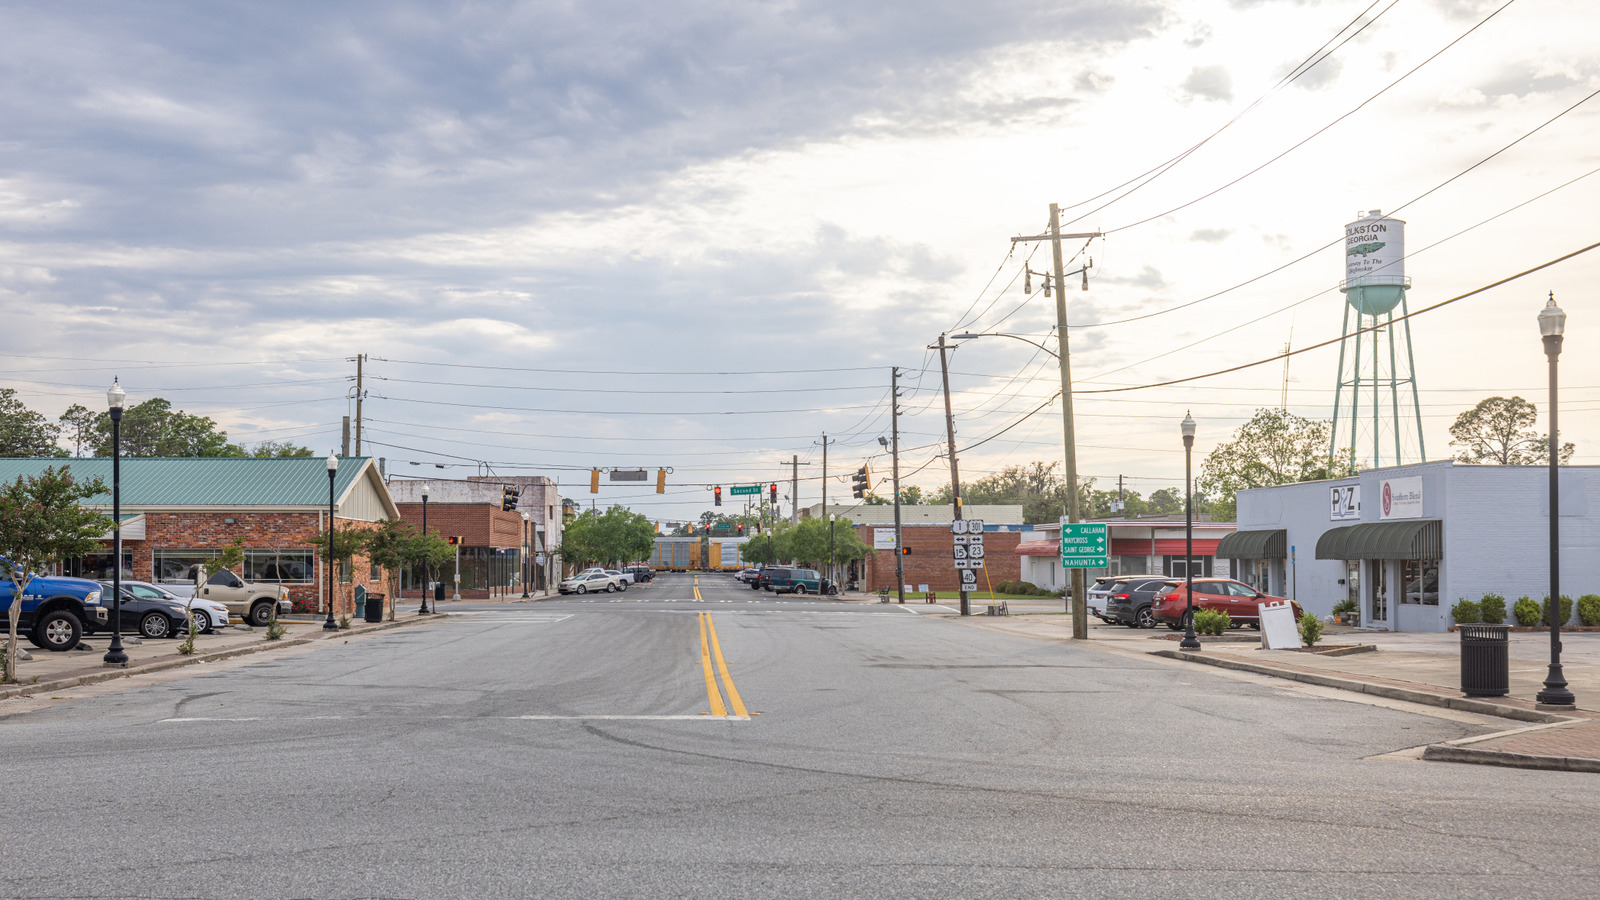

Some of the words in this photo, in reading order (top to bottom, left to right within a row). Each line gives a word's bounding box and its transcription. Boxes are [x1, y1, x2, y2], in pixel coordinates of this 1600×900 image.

[1346, 224, 1387, 236] OLKSTON
[1347, 234, 1378, 245] GEORGIA
[1409, 490, 1421, 500] Blend
[971, 522, 981, 531] 301
[955, 548, 964, 557] 15
[972, 546, 981, 556] 23
[964, 573, 973, 582] 40
